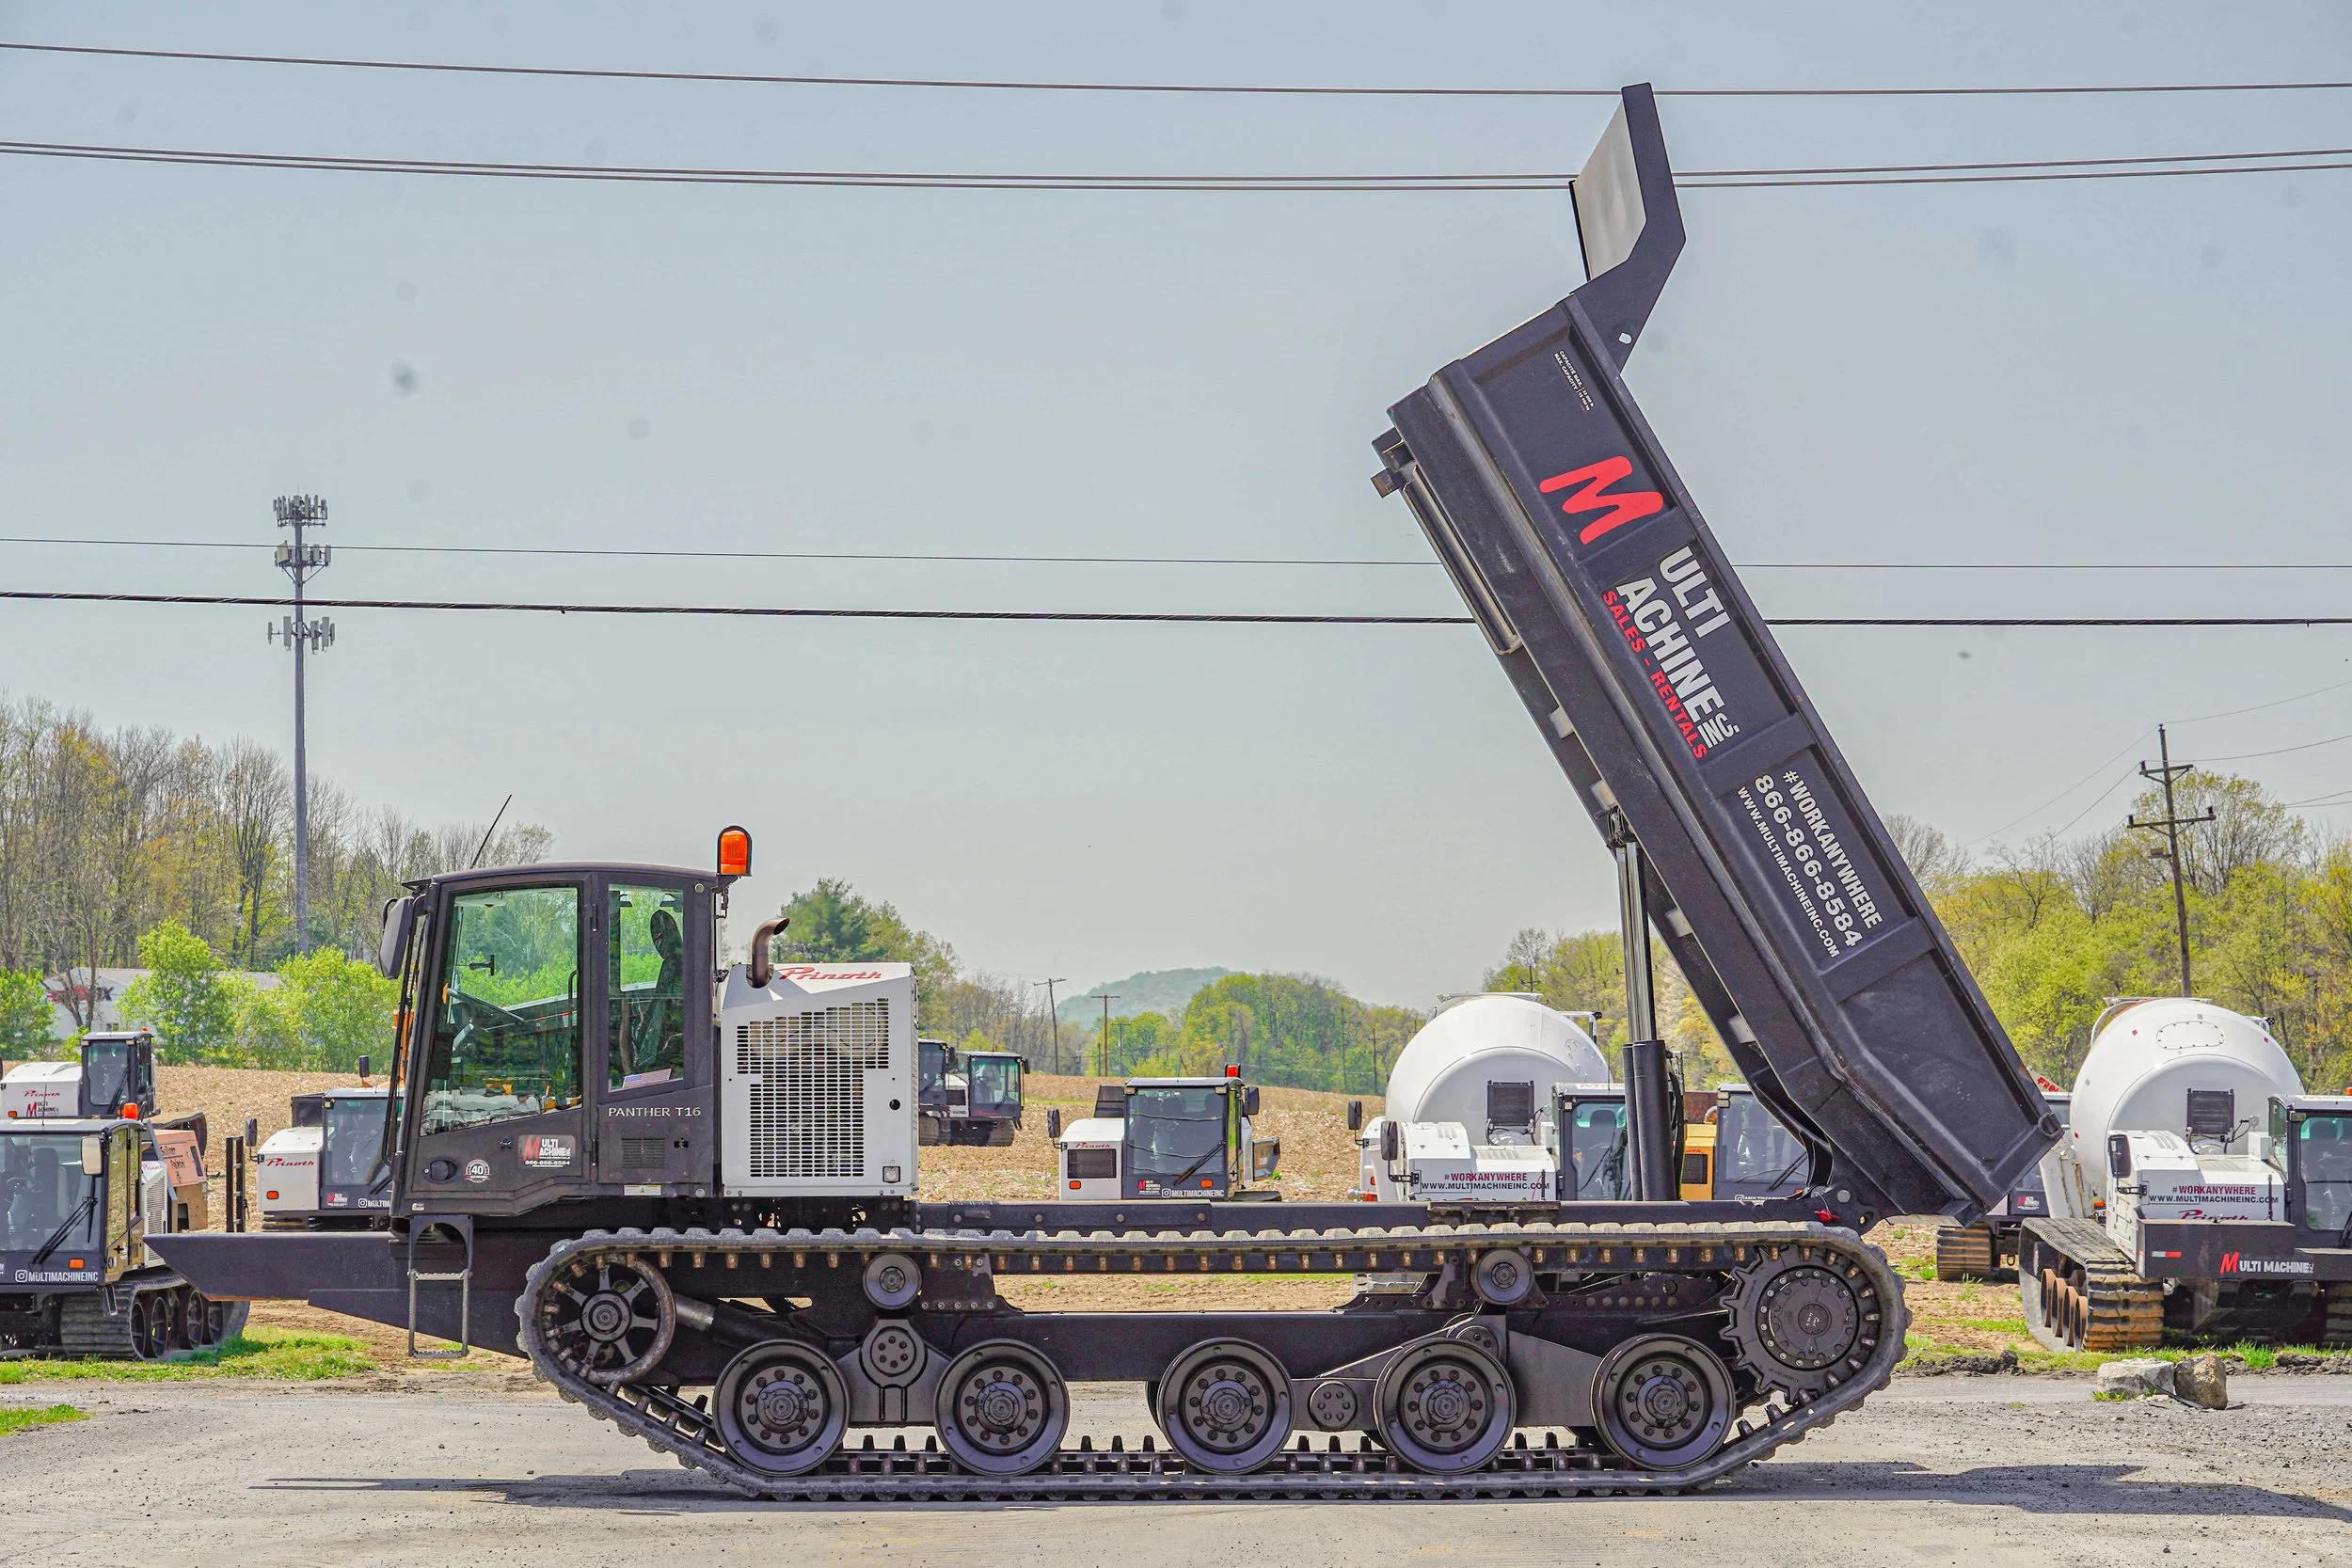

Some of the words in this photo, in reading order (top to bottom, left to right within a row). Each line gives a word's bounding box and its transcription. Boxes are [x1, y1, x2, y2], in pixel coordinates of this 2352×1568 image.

[1602, 590, 1646, 653] SALES
[1649, 671, 1708, 759] RENTALS
[1695, 712, 1740, 749] INC.
[1782, 770, 1883, 929] #WORKANYWHERE
[1755, 774, 1863, 947] 866-866-8584
[1737, 786, 1840, 958] WWW.MULTIMACHINEINC.COM
[777, 966, 882, 979] Prinoth
[608, 1107, 671, 1117] PANTHER
[675, 1107, 701, 1117] T16
[265, 1158, 315, 1166] Prinoth
[470, 1164, 485, 1175] 40
[1444, 1172, 1528, 1181] #WORKANYWHERE
[2172, 1185, 2256, 1196] #WORKANYWHERE
[2149, 1195, 2279, 1204] WWW.MULTIMACHINEINC.COM
[2264, 1260, 2310, 1274] MACHINE
[28, 1271, 99, 1282] MULTIMACHINEINC
